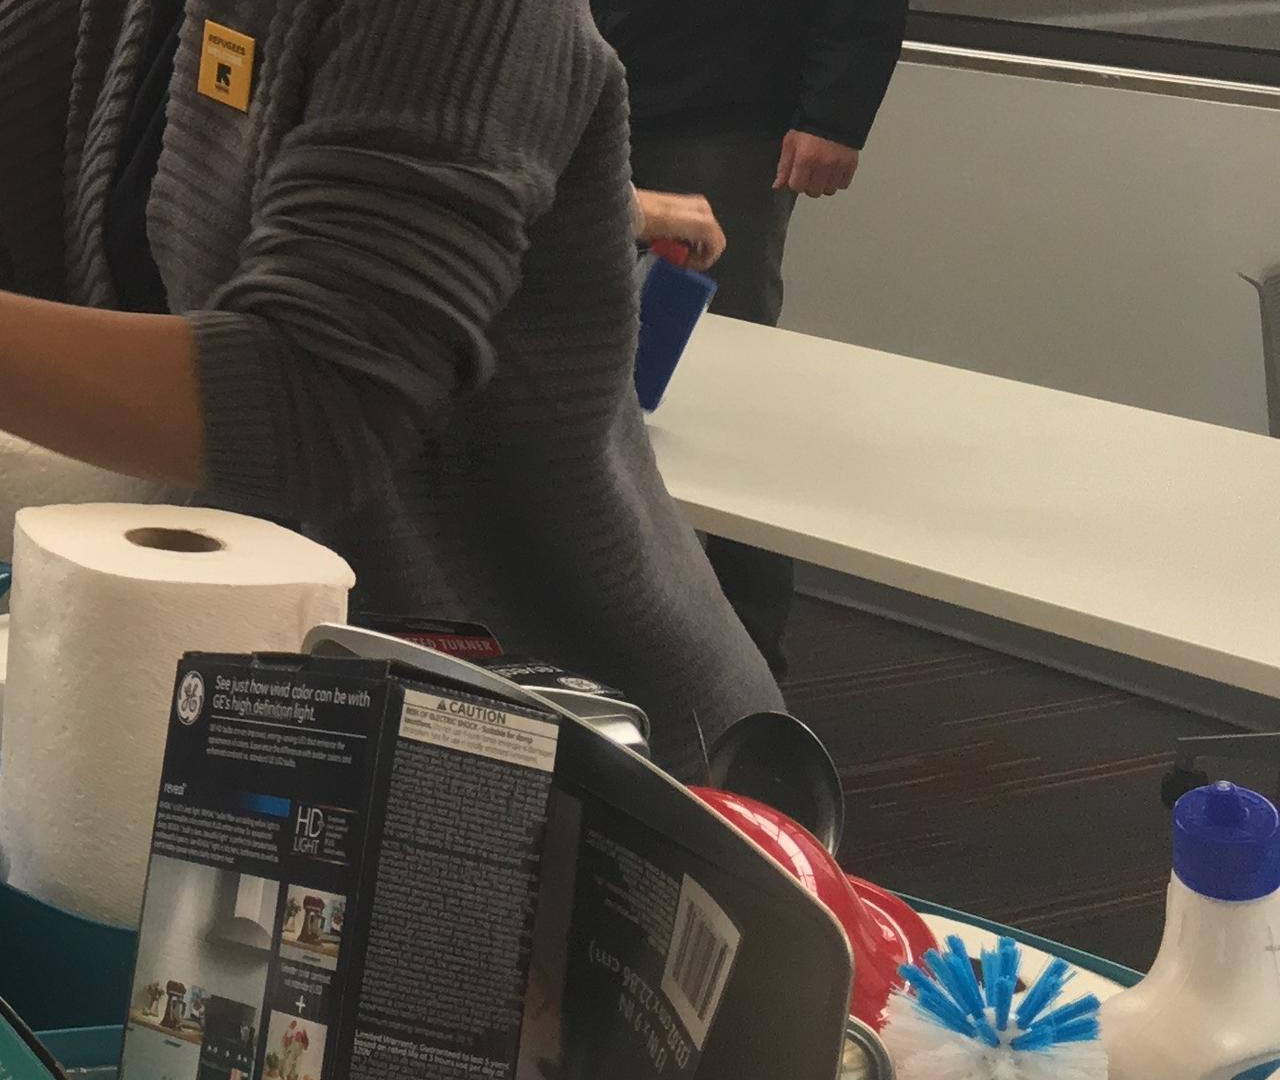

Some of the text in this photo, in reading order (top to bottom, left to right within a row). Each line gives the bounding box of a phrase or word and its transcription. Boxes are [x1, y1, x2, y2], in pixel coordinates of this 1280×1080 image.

[215, 675, 231, 691] See
[231, 678, 249, 694] just
[250, 679, 269, 694] how
[291, 684, 313, 699] color
[315, 691, 332, 702] can
[334, 688, 346, 704] be
[348, 690, 370, 707] with
[232, 698, 252, 716] high
[449, 701, 507, 724] CAUTION
